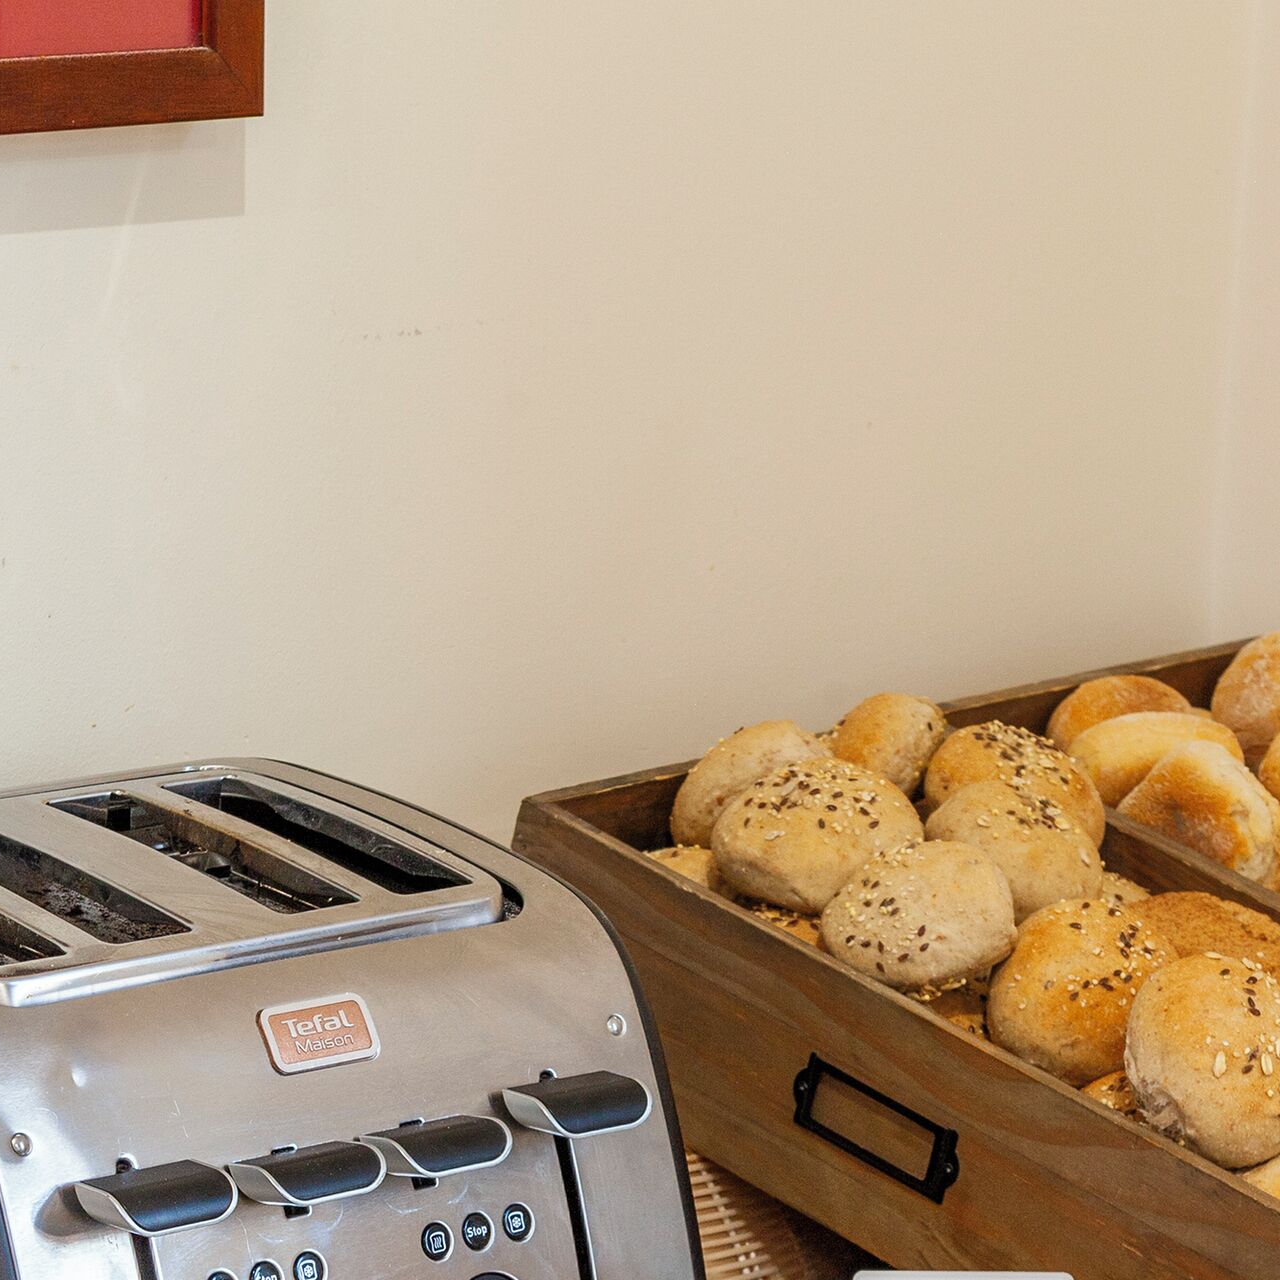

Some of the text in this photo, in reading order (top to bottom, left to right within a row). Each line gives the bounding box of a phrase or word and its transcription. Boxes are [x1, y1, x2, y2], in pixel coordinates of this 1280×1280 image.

[281, 1009, 354, 1038] Tefal
[295, 1034, 354, 1054] Maison
[467, 1223, 487, 1238] Stop
